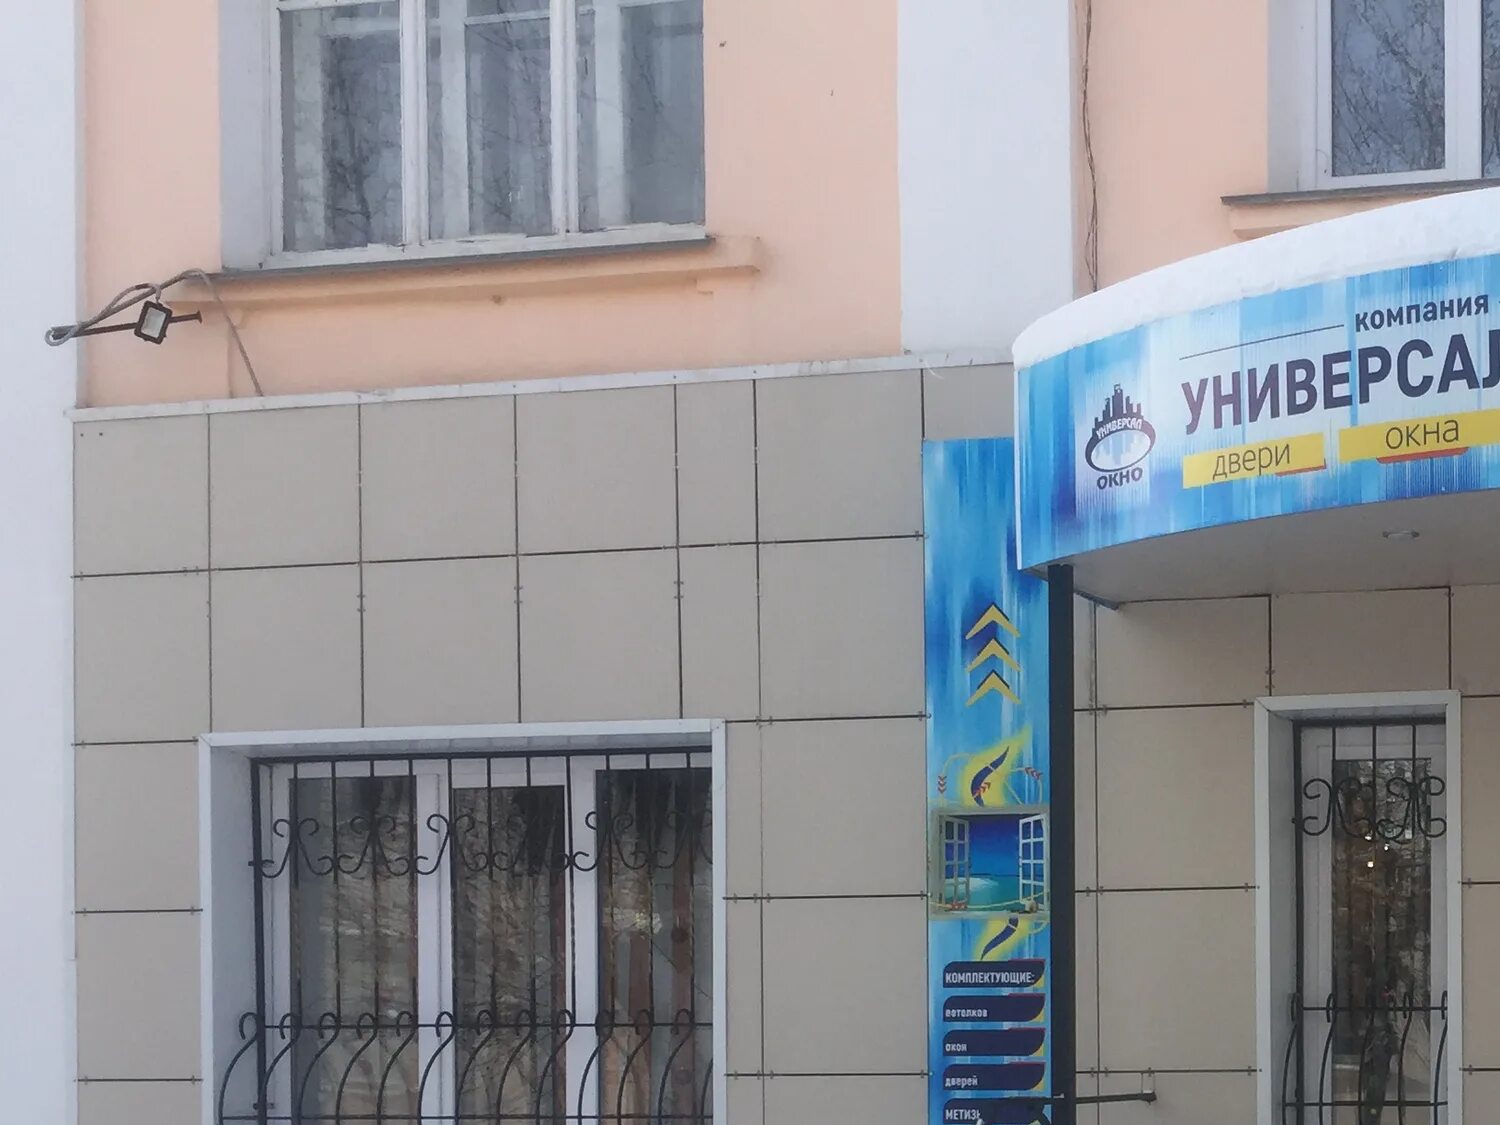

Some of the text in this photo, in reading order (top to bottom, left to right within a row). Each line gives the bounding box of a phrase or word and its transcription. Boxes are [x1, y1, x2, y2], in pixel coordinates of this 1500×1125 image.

[1355, 294, 1489, 332] компания
[1096, 417, 1143, 439] УНИВЕРСАЛ
[1212, 444, 1290, 481] двери
[1385, 418, 1459, 449] окна
[1096, 467, 1143, 490] ОКНО
[945, 1042, 967, 1051] окон
[945, 1075, 978, 1087] дверей
